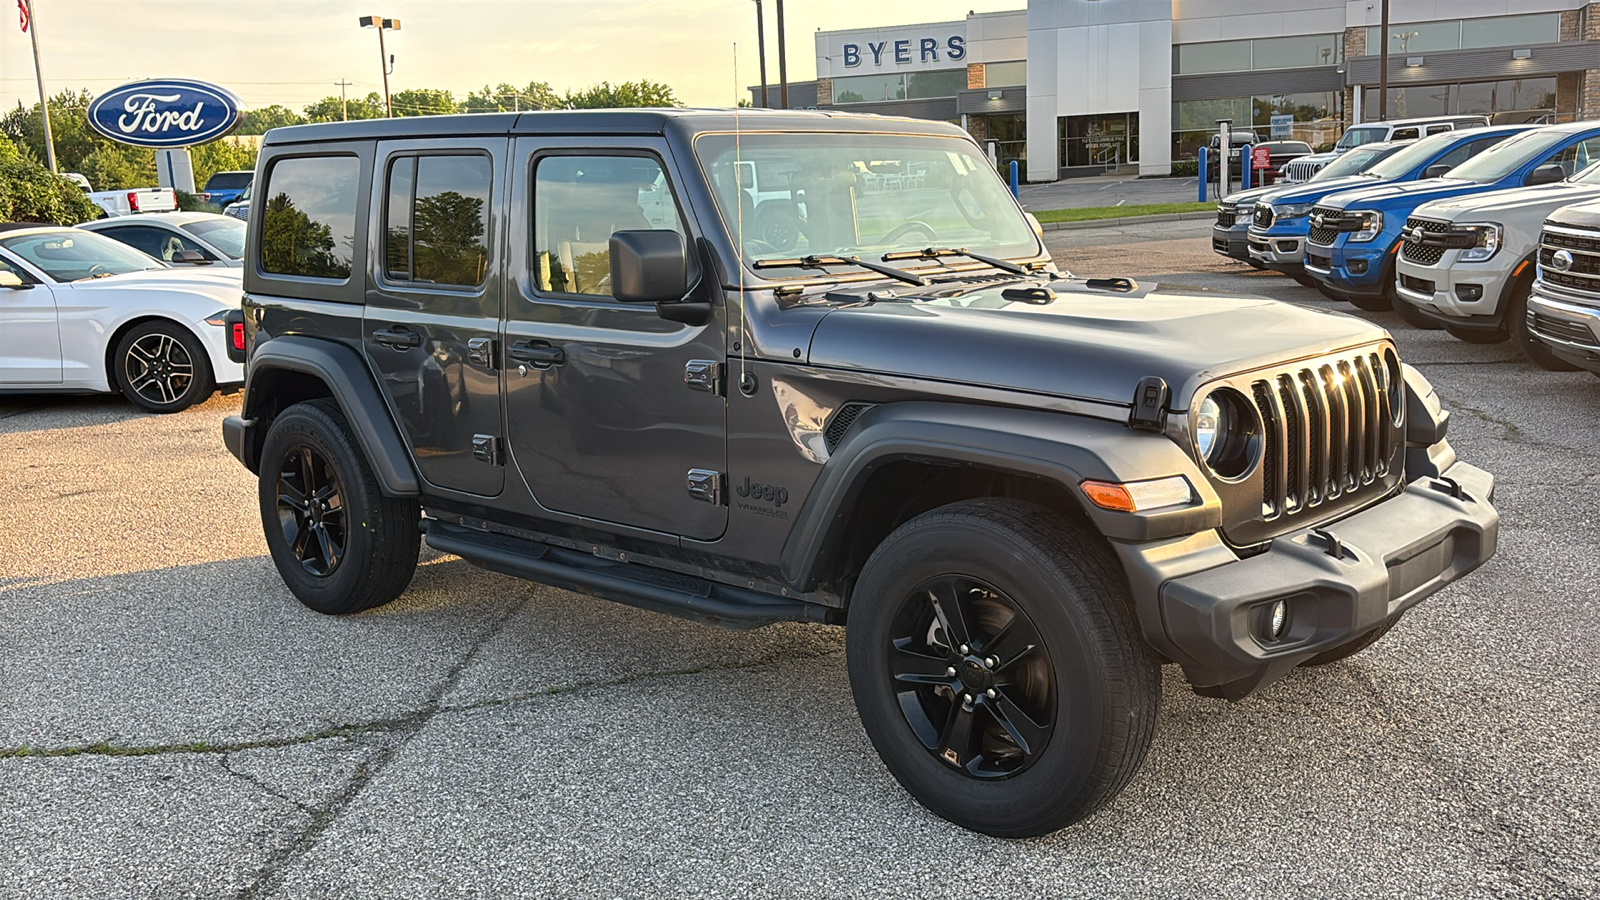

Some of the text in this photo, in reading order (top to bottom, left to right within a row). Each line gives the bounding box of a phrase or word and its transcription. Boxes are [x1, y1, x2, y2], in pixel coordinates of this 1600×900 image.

[843, 36, 966, 68] BYERS
[118, 93, 205, 133] Ford
[736, 477, 788, 507] Jeep
[737, 501, 788, 519] WRANGLER
